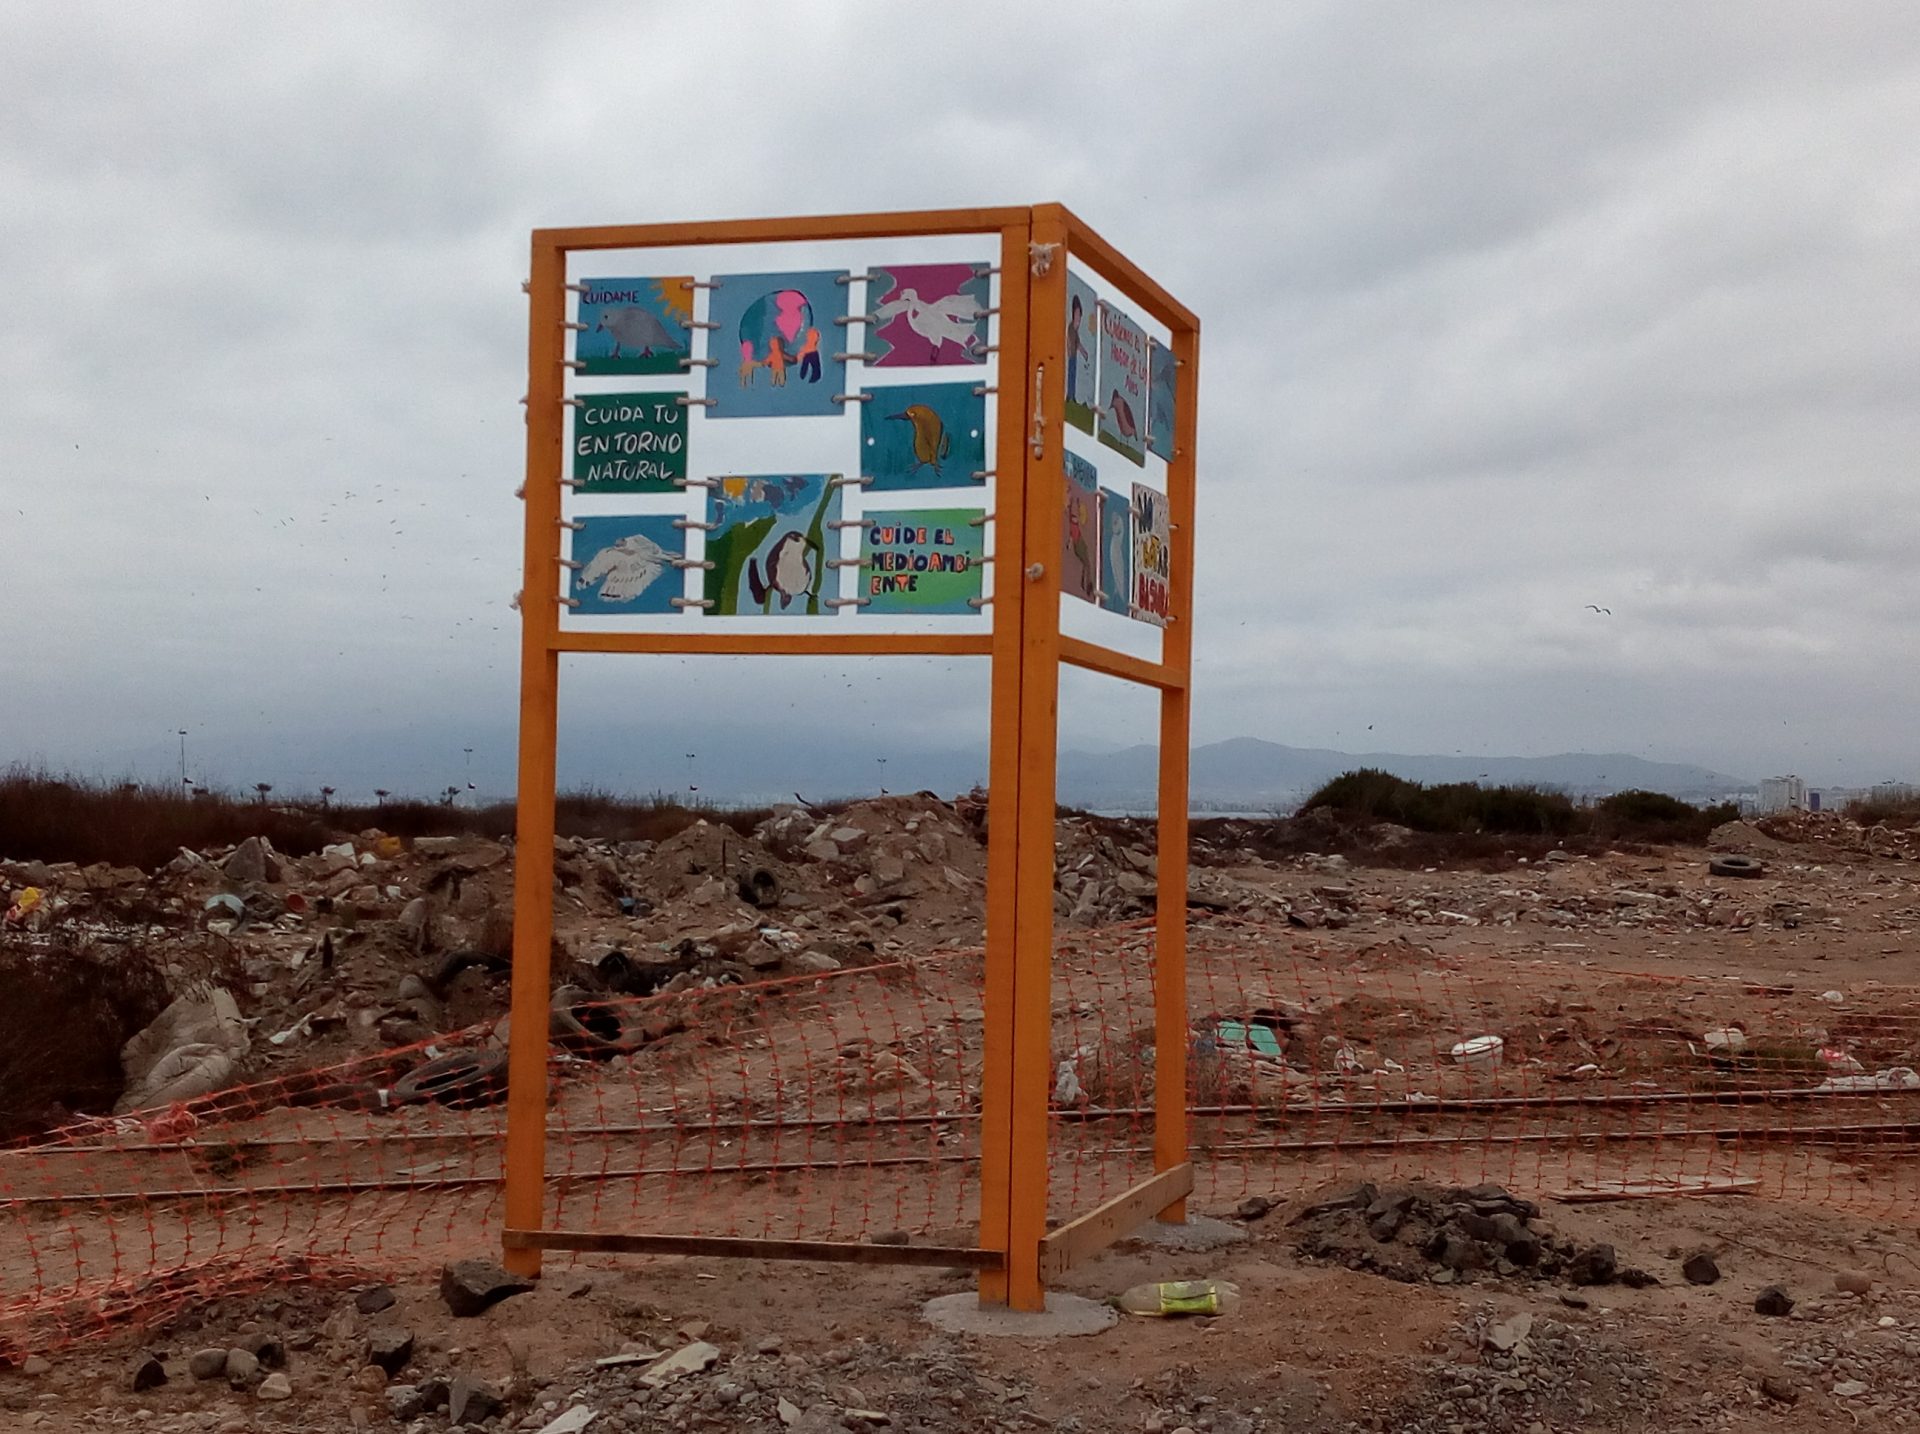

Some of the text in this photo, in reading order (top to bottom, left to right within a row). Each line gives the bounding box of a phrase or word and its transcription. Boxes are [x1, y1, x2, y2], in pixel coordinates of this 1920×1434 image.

[585, 400, 678, 424] CUIDA TU
[578, 431, 682, 455] ENTORNO
[588, 459, 673, 481] NATURAL
[869, 522, 954, 545] CUIDE EL
[870, 574, 918, 595] ENTE
